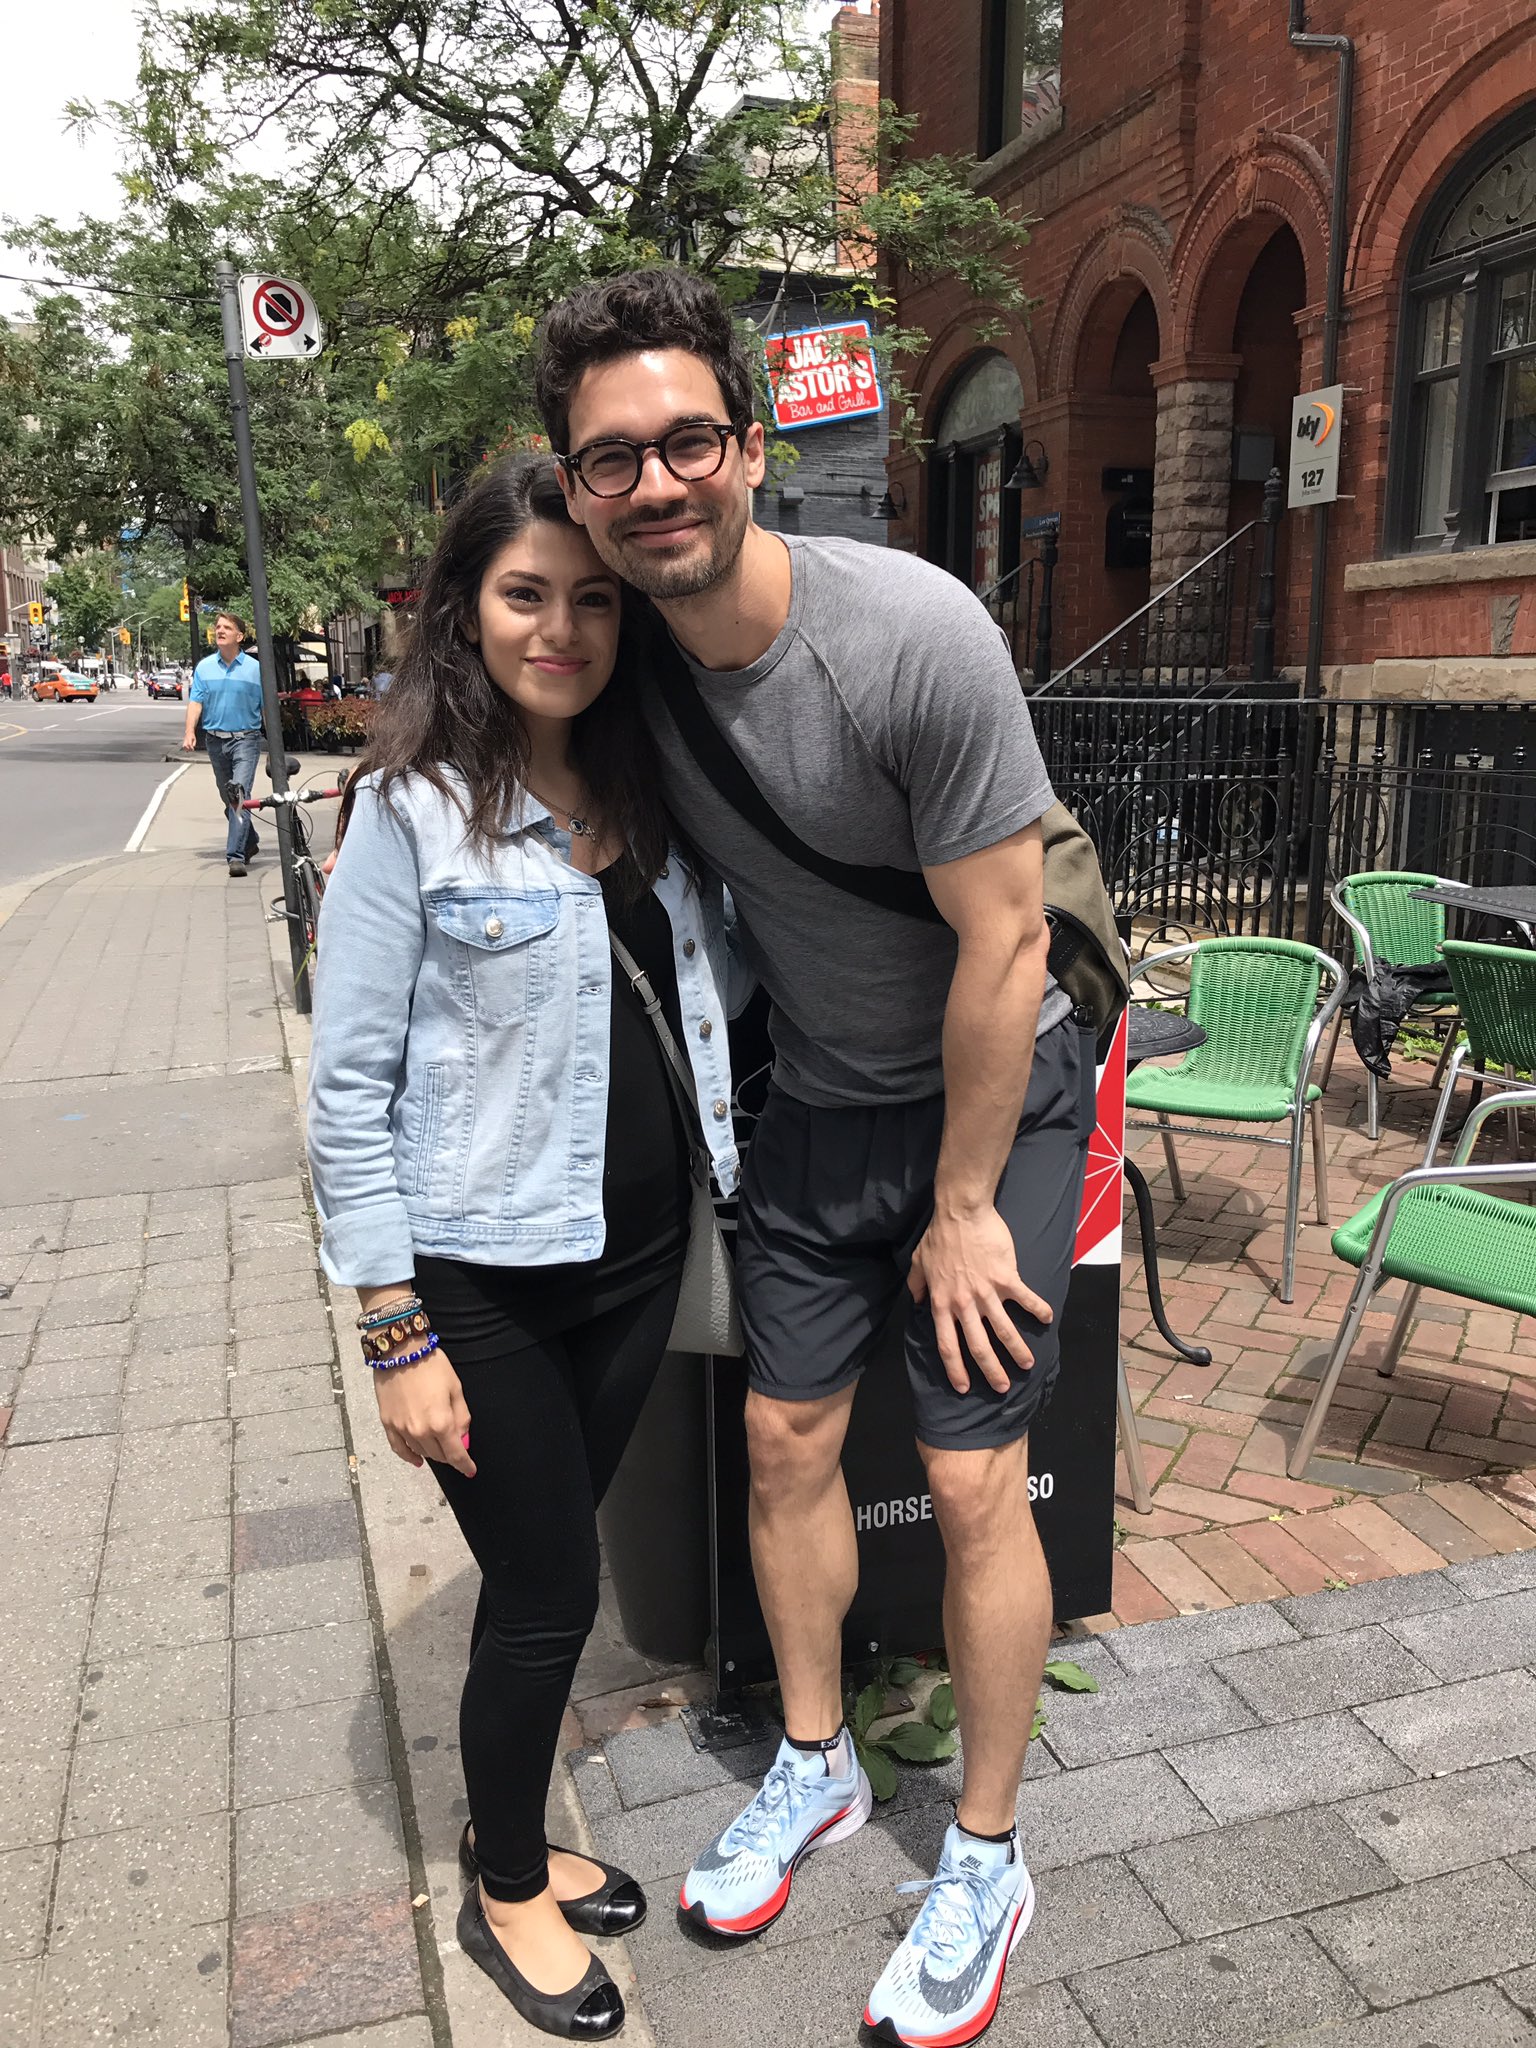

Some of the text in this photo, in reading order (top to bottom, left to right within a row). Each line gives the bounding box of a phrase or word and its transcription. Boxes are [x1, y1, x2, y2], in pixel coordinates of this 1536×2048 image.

[788, 403, 813, 419] Bar
[816, 397, 836, 413] and
[1297, 415, 1321, 440] bty
[1301, 468, 1324, 489] 127
[857, 1494, 933, 1531] HORSE
[964, 1854, 983, 1870] NIKE
